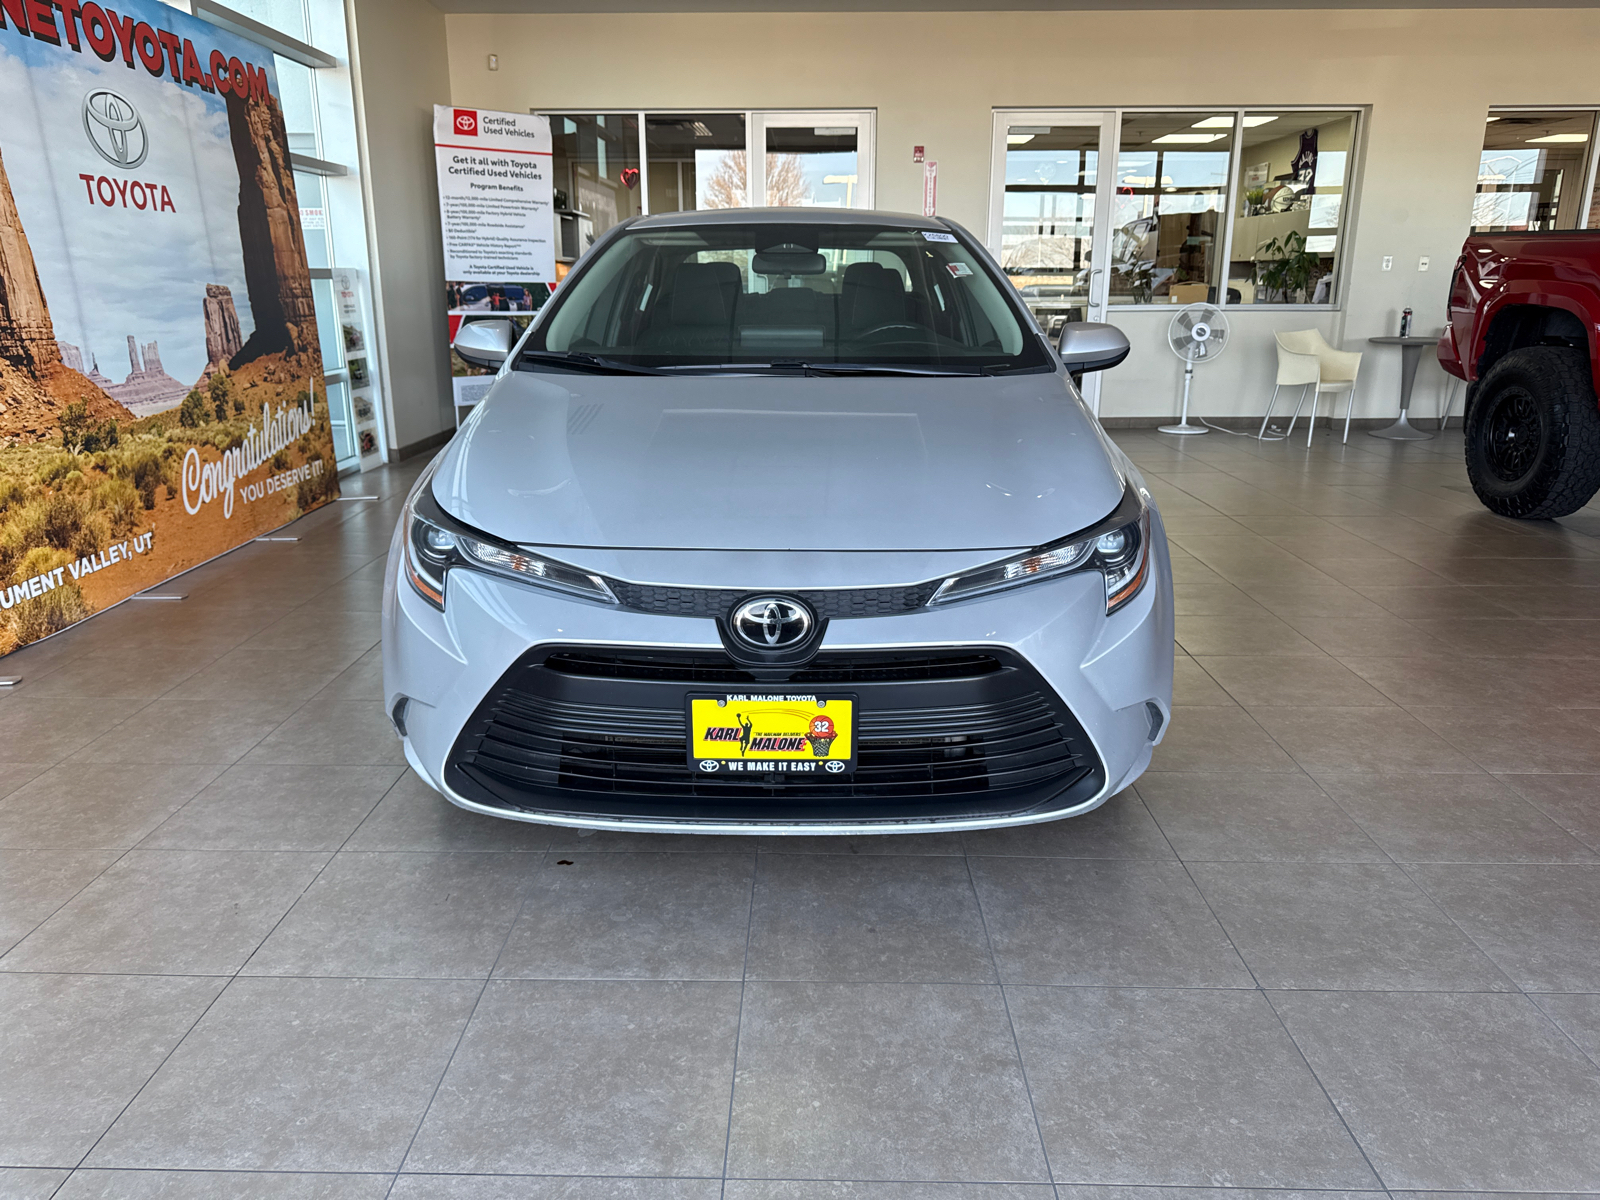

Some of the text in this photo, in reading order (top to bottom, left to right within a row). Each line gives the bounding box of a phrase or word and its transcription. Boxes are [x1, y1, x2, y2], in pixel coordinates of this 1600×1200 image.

[483, 116, 516, 126] Certified
[484, 126, 535, 138] Used Vehicles
[452, 156, 537, 170] Get it all with Toyota
[448, 166, 542, 180] Certified Used Vehicles
[79, 173, 176, 214] TOYOTA
[470, 182, 497, 191] Program
[182, 377, 316, 519] Congratulations!
[240, 459, 324, 504] YOU DESERVE IT!
[0, 532, 152, 612] UMENT VALLEY, UT
[814, 721, 829, 732] 32
[703, 727, 742, 742] KARL
[748, 738, 807, 751] MALONE
[728, 762, 816, 771] WE MAKE IT EASY
